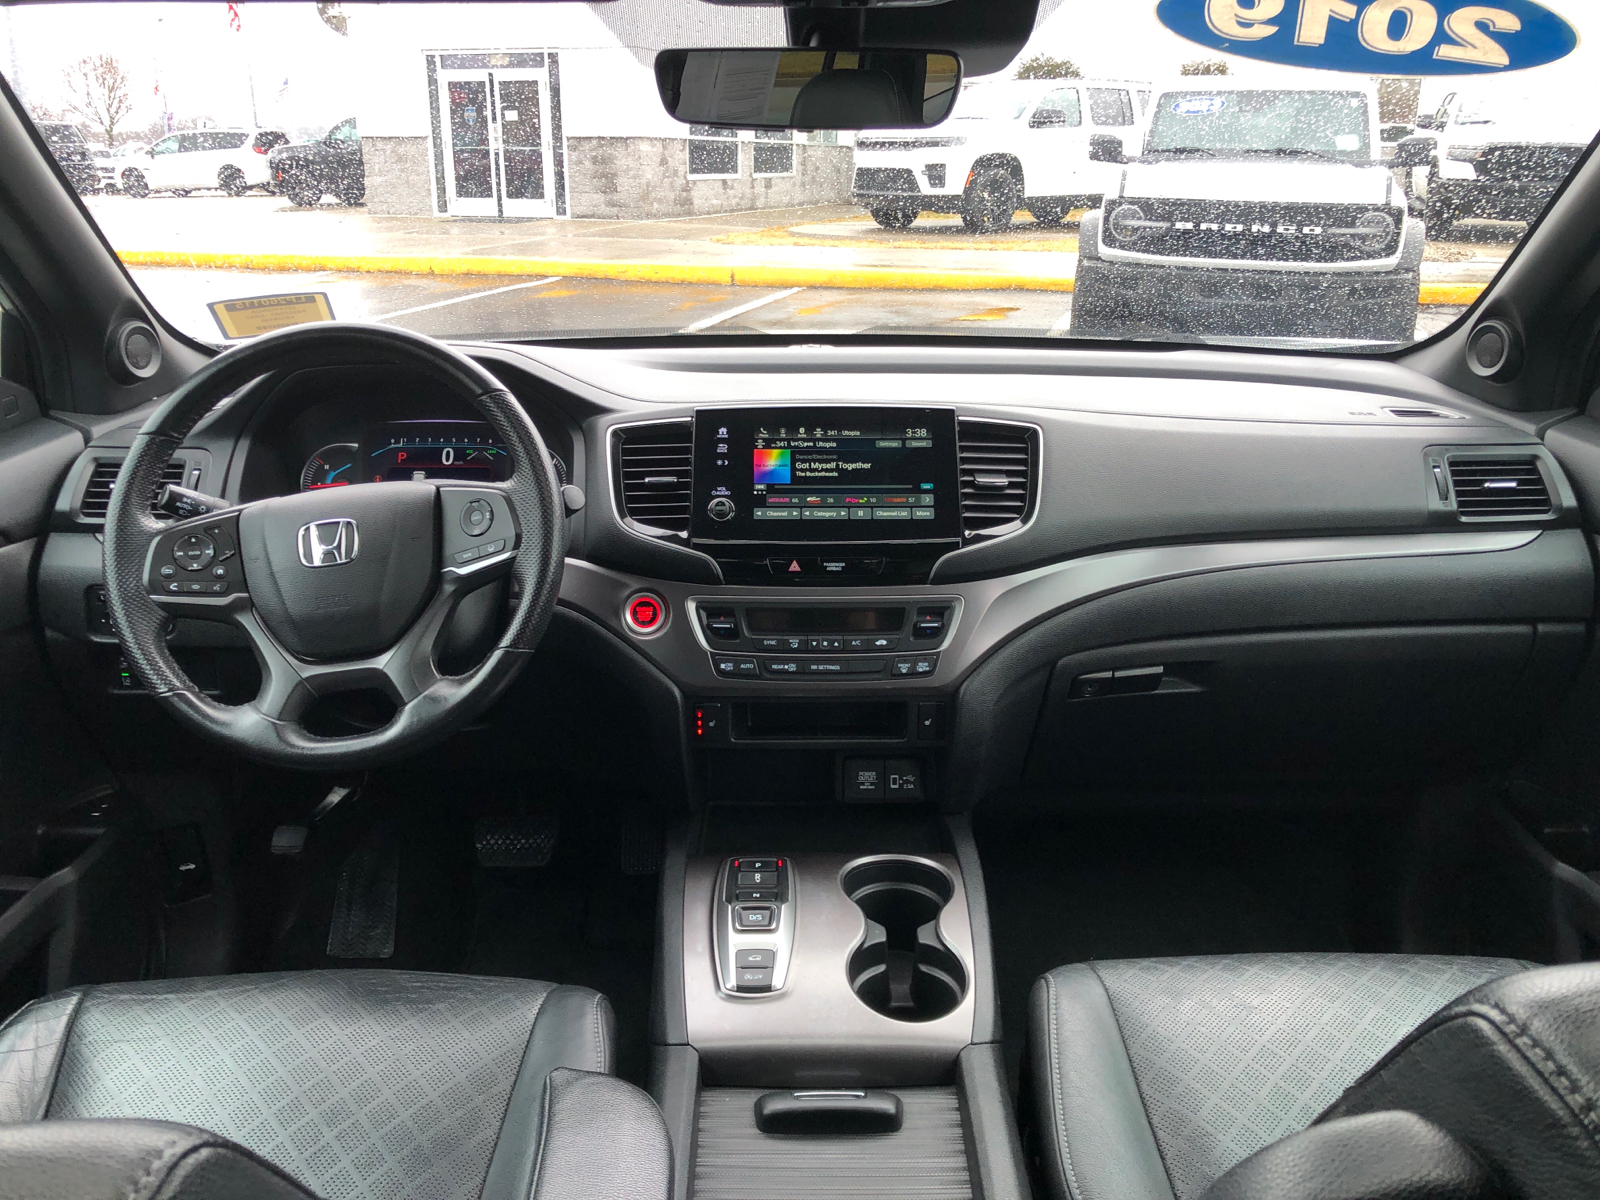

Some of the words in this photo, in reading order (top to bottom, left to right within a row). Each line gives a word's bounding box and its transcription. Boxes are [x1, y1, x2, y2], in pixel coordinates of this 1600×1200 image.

[1174, 221, 1323, 236] BRONCO
[905, 428, 927, 437] 3:38
[397, 452, 407, 463] P
[441, 447, 454, 466] 0
[811, 462, 837, 471] Myself
[838, 462, 872, 471] Together
